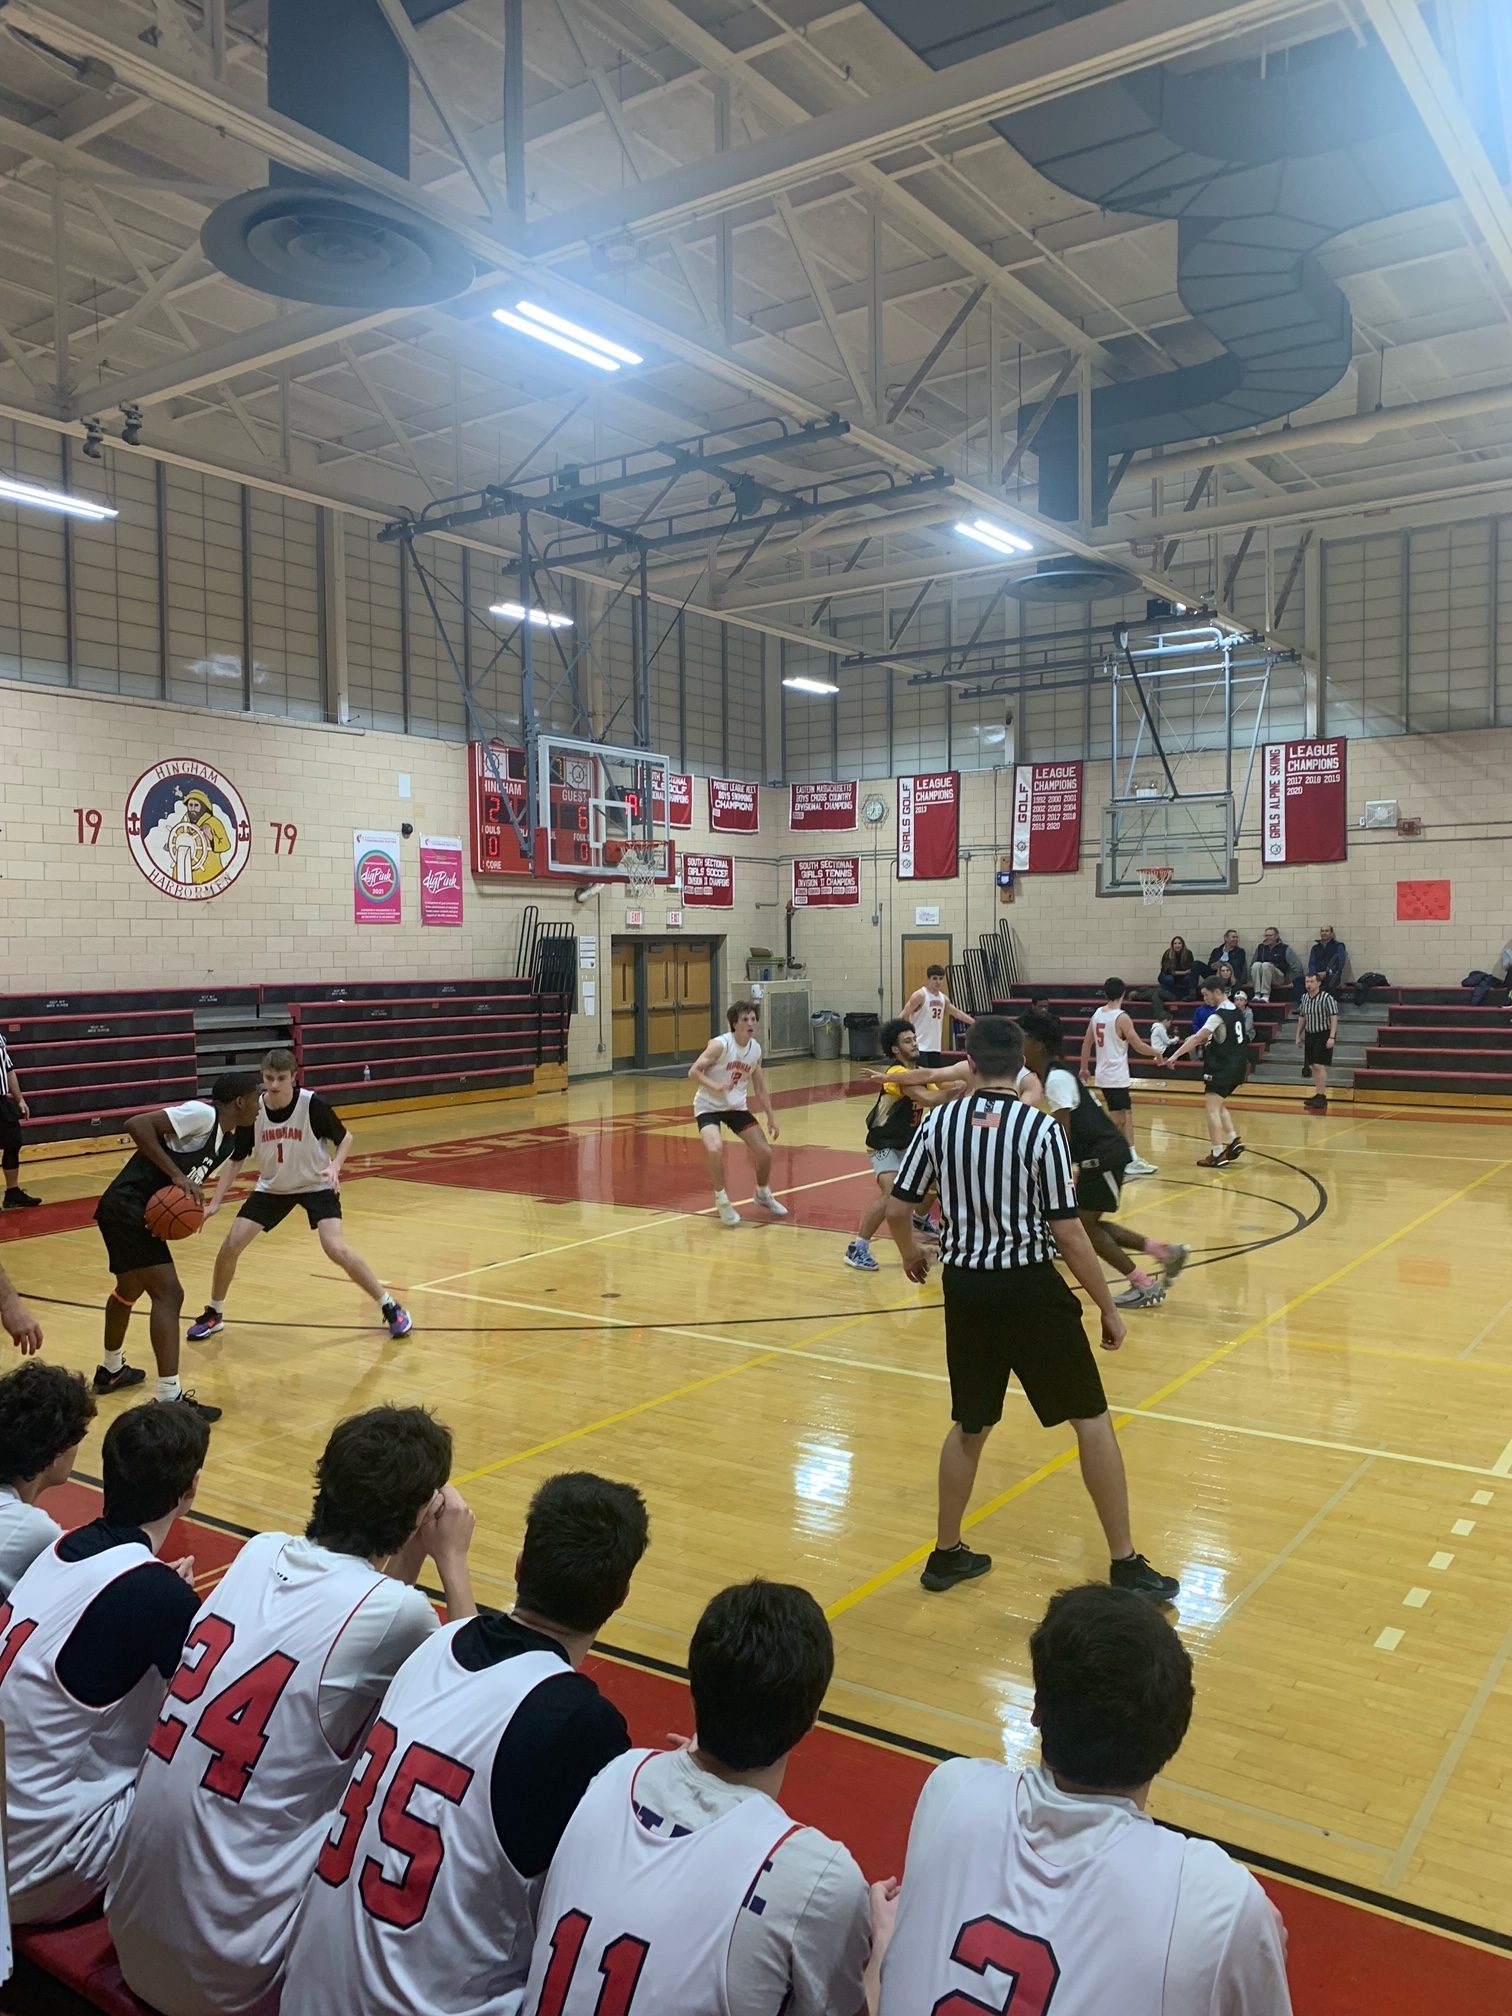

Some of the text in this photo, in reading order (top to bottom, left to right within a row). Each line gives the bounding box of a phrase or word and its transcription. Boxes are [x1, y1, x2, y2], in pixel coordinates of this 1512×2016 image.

[1289, 744, 1338, 758] LEAGUE
[1287, 758, 1340, 772] CHAMPIONS
[155, 761, 219, 784] HINGHAM
[1035, 766, 1076, 779] LEAGUE
[1286, 777, 1302, 785] 2017
[1323, 774, 1340, 783] 2019
[730, 782, 746, 793] LEAGUE
[796, 785, 815, 793] EASTERN
[916, 777, 953, 790] LEAGUE
[1033, 779, 1078, 792] CHAMPIONS
[562, 789, 587, 804] GUEST
[796, 792, 852, 803] BOYS CROSS COUNTRY
[915, 789, 954, 802] CHAMPIONS
[1269, 748, 1281, 839] GIRLS ALPINE SKIING
[714, 799, 754, 812] CHAMPIONS
[795, 801, 853, 811] DIVISIONAL CHAMPIONS
[1018, 783, 1028, 823] GOLF
[578, 806, 588, 830] 6
[902, 783, 911, 853] GIRLS GOLF
[73, 808, 103, 845] 19
[269, 822, 298, 855] 79
[488, 836, 589, 861] 0 0
[687, 857, 729, 869] SOUTH SECTIONAL
[798, 860, 854, 870] SOUTH SECTIONAL
[687, 866, 729, 878] GIRLS SOCCER
[801, 869, 853, 879] GIRLS TENNIS
[149, 868, 233, 899] HARBORMEN
[709, 877, 730, 888] CHAMPIONS
[797, 879, 818, 888] DIVISION
[826, 877, 856, 886] CHAMPIONS
[1095, 1022, 1106, 1048] 5
[1235, 1020, 1244, 1044] 9
[277, 1142, 284, 1164] 1
[148, 1612, 300, 1804] 24
[313, 1717, 476, 1932] 35
[534, 1907, 651, 2016] 11
[930, 1913, 1061, 2016] 2
